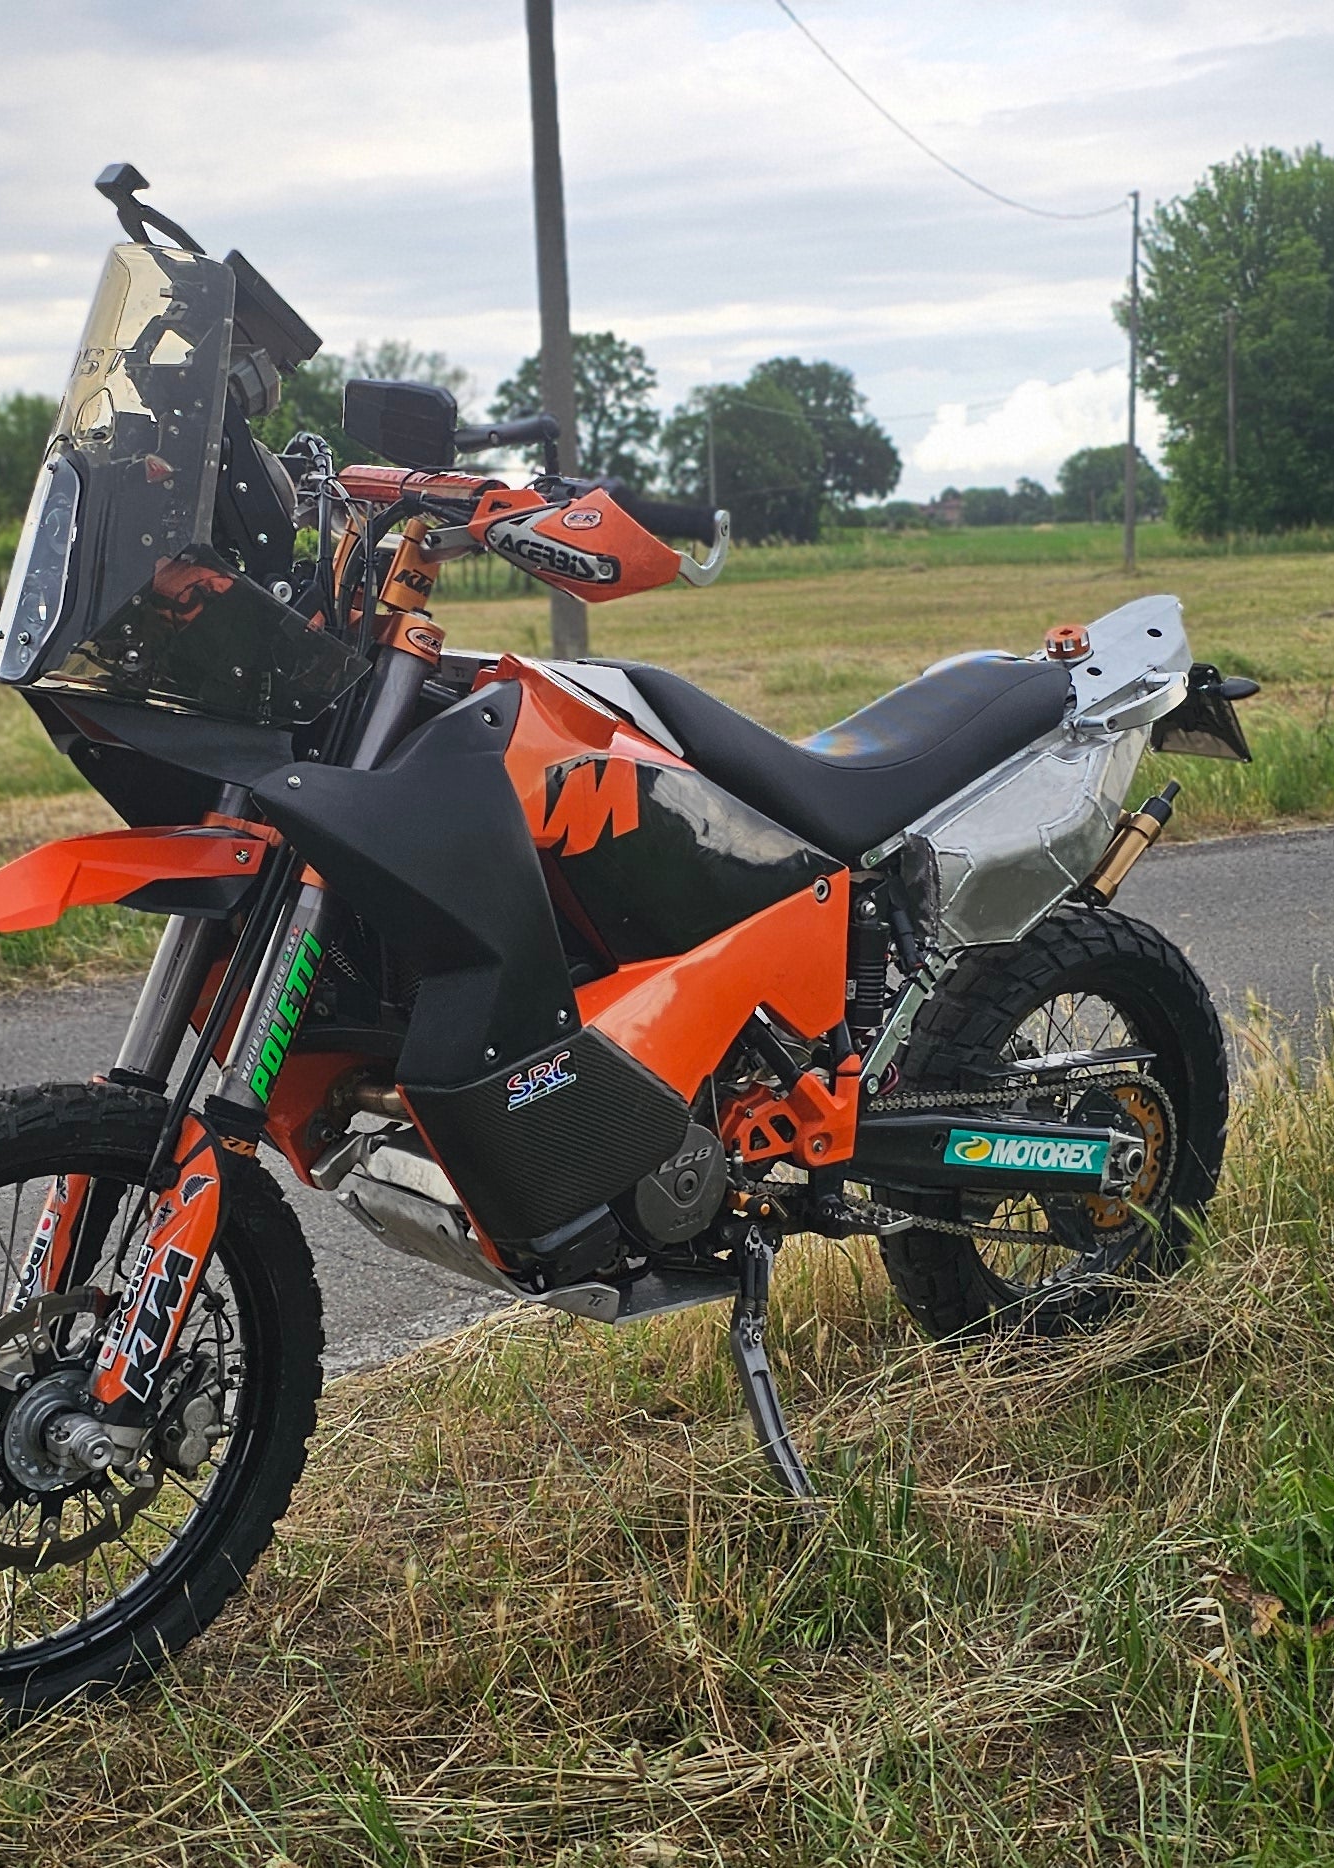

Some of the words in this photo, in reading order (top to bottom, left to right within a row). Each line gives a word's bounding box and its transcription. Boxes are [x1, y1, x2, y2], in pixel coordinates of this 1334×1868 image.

[393, 568, 434, 597] KTM
[240, 1040, 261, 1084] world
[257, 963, 287, 1034] champion
[249, 927, 323, 1105] POLETTI
[507, 1050, 571, 1104] SRC
[658, 1145, 714, 1175] LC8
[990, 1138, 1098, 1170] MOTOREX
[120, 1244, 198, 1404] KTM
